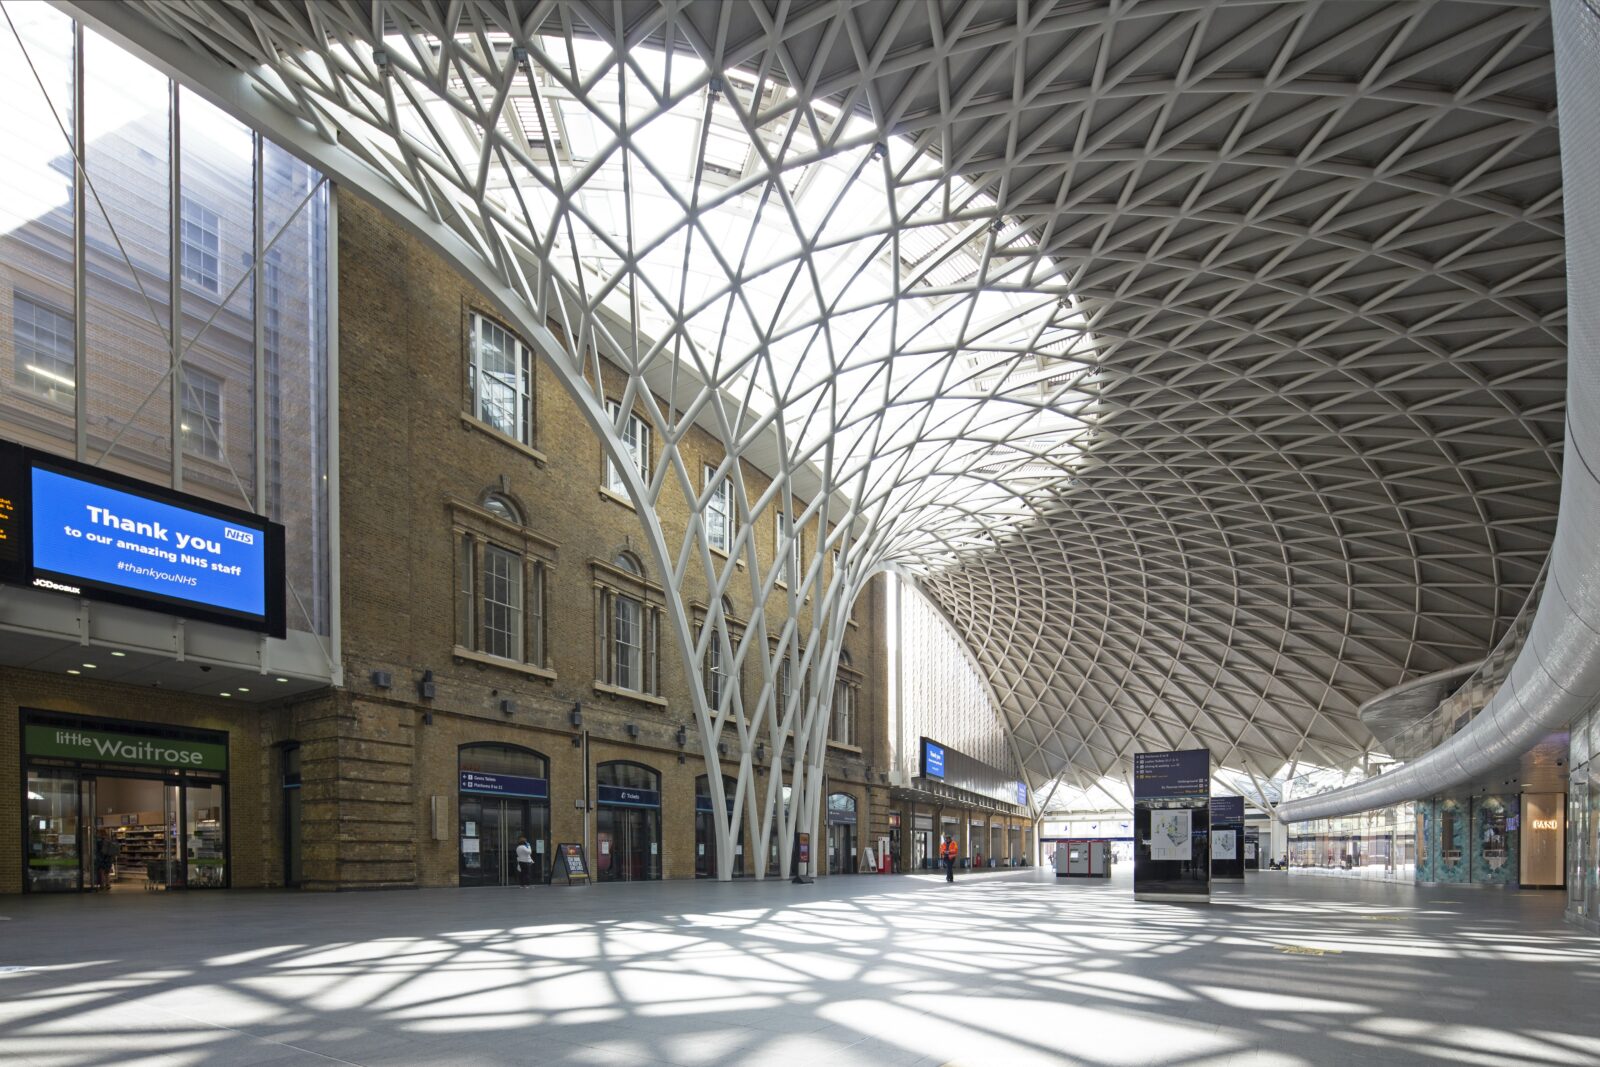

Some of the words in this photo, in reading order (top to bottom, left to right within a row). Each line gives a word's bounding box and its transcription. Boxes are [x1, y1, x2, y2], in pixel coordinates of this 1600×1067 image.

[86, 505, 169, 542] Thank
[175, 531, 221, 555] you
[226, 529, 252, 544] NHS
[64, 525, 82, 538] to
[86, 532, 113, 545] our
[116, 540, 178, 563] amazing
[180, 553, 208, 568] NHS
[211, 562, 242, 576] staff
[33, 578, 81, 594] JCDecaux
[117, 560, 198, 587] #thankyouNHS
[56, 731, 92, 747] little
[93, 738, 204, 765] Waitrose
